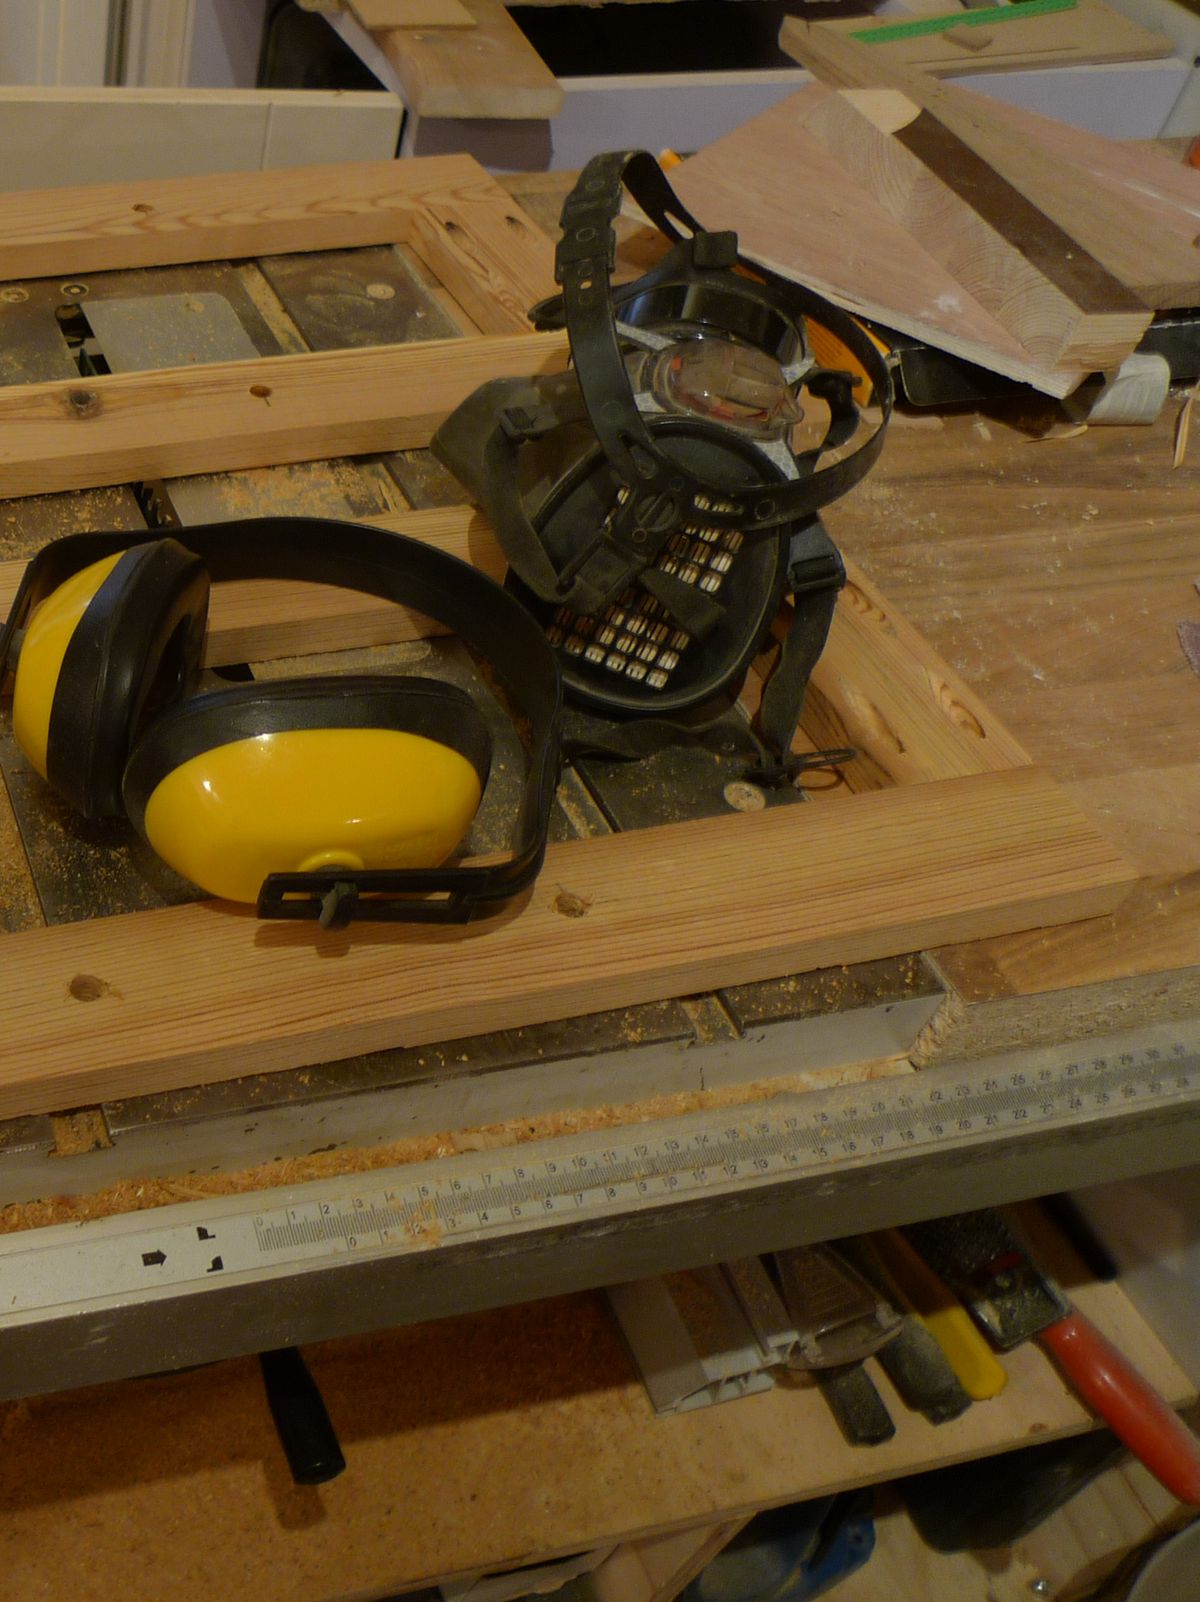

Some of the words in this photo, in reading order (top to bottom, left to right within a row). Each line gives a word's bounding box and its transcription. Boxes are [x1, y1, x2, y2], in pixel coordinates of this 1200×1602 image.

[572, 1158, 587, 1169] 10
[603, 1153, 617, 1161] 11
[634, 1146, 647, 1156] 12
[664, 1141, 679, 1151] 13
[695, 1136, 709, 1144] 14
[725, 1129, 739, 1139] 15
[784, 1118, 797, 1128] 17
[813, 1112, 828, 1122] 18
[872, 1102, 885, 1112] 20
[930, 1089, 944, 1101] 22
[956, 1085, 970, 1097] 23
[984, 1079, 998, 1091] 24
[664, 1177, 677, 1187] 10
[723, 1165, 737, 1176] 12
[753, 1159, 768, 1169] 13
[783, 1154, 797, 1163] 14
[813, 1148, 827, 1157] 15
[842, 1142, 857, 1152] 16
[872, 1137, 884, 1146] 17
[900, 1130, 914, 1141] 18
[929, 1125, 943, 1136] 19
[957, 1119, 971, 1130] 20
[984, 1114, 999, 1125] 21
